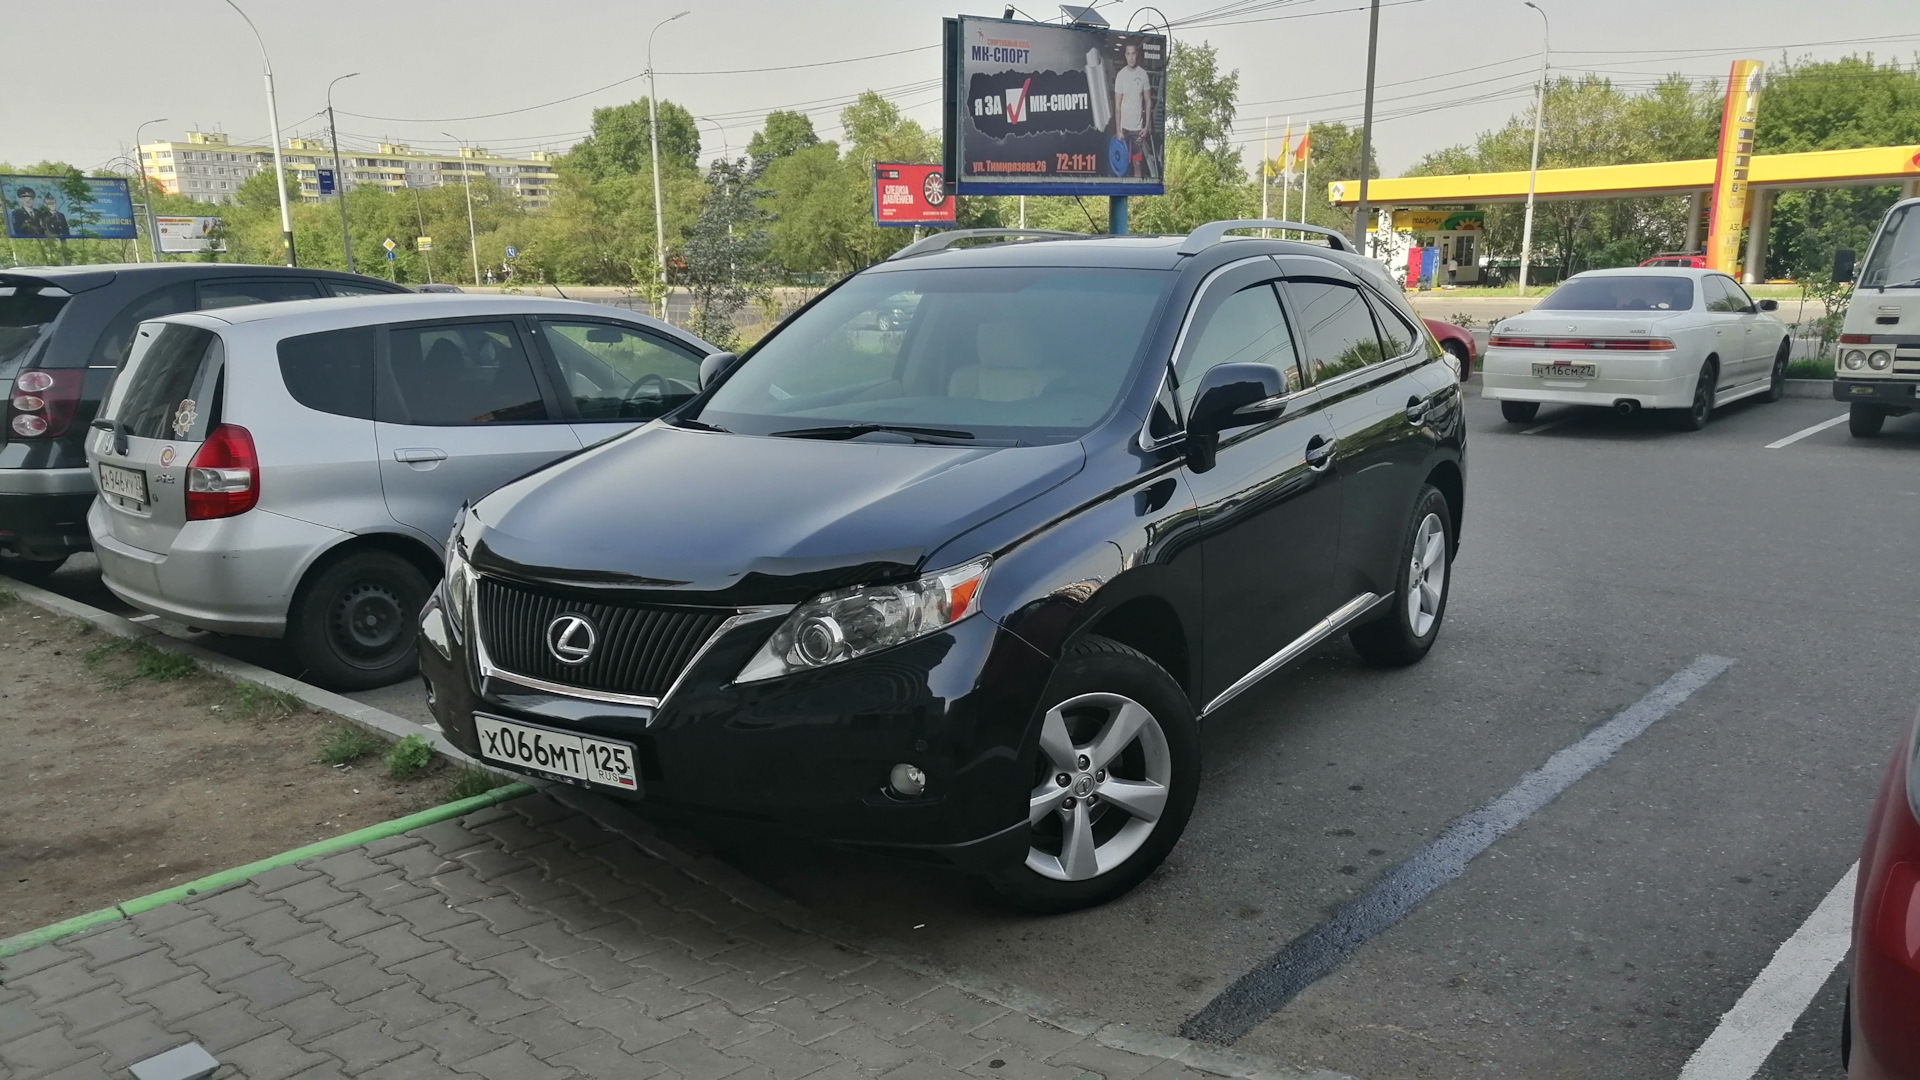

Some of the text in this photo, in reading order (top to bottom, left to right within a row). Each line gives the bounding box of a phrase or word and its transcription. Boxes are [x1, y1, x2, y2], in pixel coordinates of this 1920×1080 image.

[971, 45, 1030, 65] МК-СПОРТ
[985, 95, 1003, 116] ЗА
[1029, 93, 1088, 113] МК-СПОРТ!
[973, 161, 985, 173] ул.
[1055, 153, 1096, 171] 72-11-11
[1729, 223, 1740, 231] АЗС
[484, 727, 628, 775] Х066МТ 125
[598, 769, 619, 783] RUS
